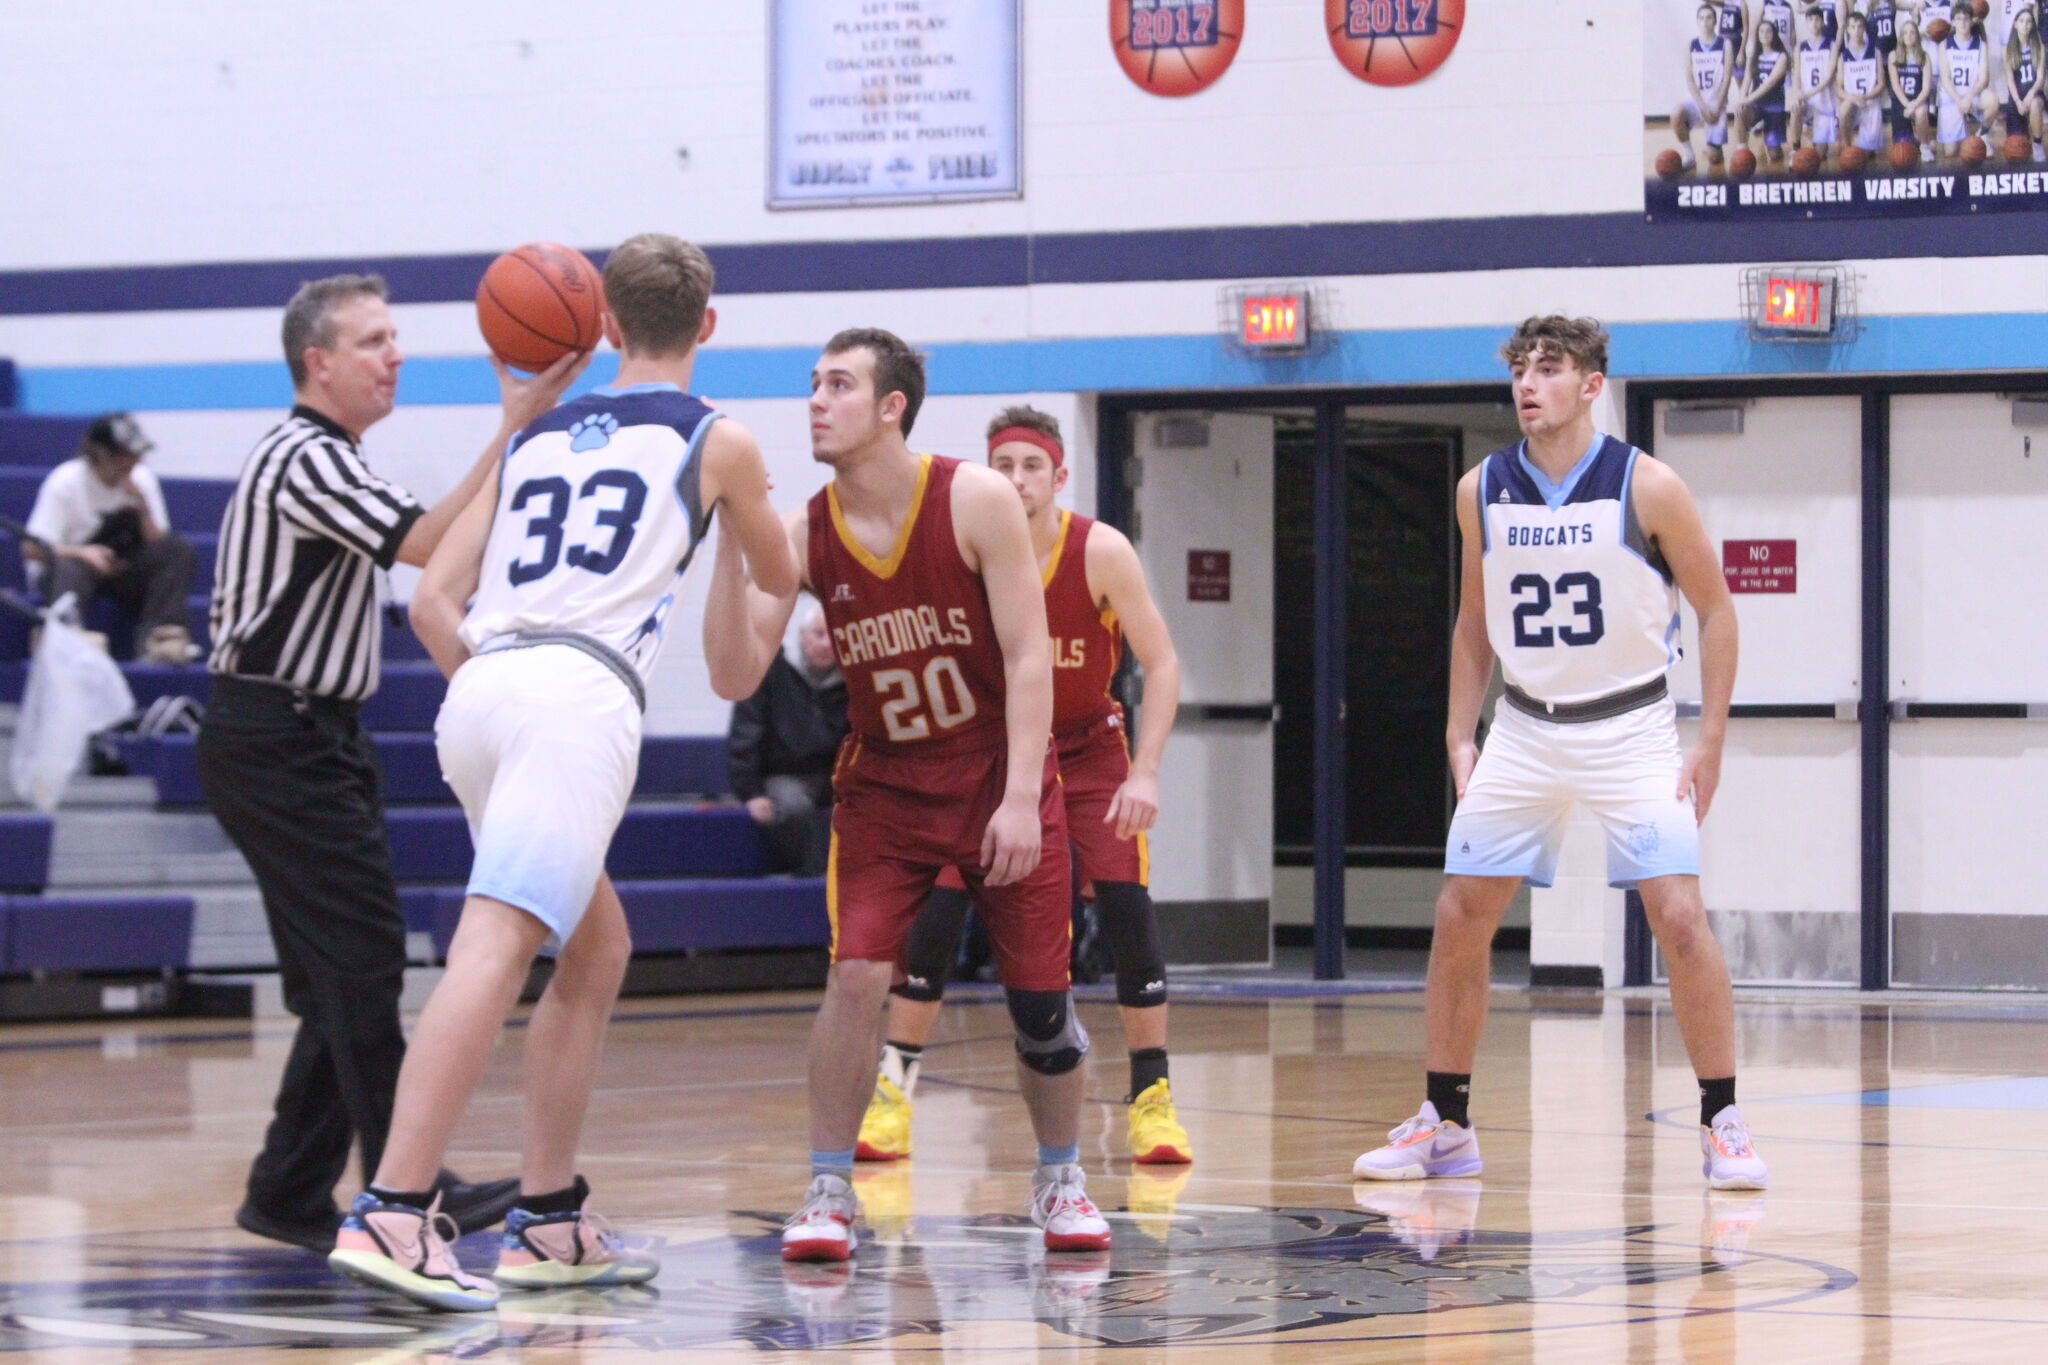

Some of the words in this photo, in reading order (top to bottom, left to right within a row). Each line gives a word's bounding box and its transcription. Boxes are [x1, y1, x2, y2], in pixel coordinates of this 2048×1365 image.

[1133, 4, 1212, 45] 2017
[1350, 0, 1431, 34] 2017
[1876, 19, 1893, 37] 10
[1698, 70, 1715, 90] 15
[1810, 68, 1821, 87] 6
[1953, 67, 1970, 87] 21
[2019, 64, 2034, 83] 11
[1855, 78, 1867, 95] 5
[1899, 76, 1916, 95] 12
[1678, 184, 1727, 207] 2021
[1739, 180, 1852, 206] BRETHREN
[1864, 176, 1955, 201] VARSITY
[1766, 278, 1824, 325] EXIT
[508, 468, 648, 588] 33
[1508, 523, 1593, 546] BOBCATS
[1749, 545, 1769, 561] NO
[1510, 571, 1605, 648] 23
[833, 604, 972, 666] CARDINALS
[872, 655, 976, 741] 20
